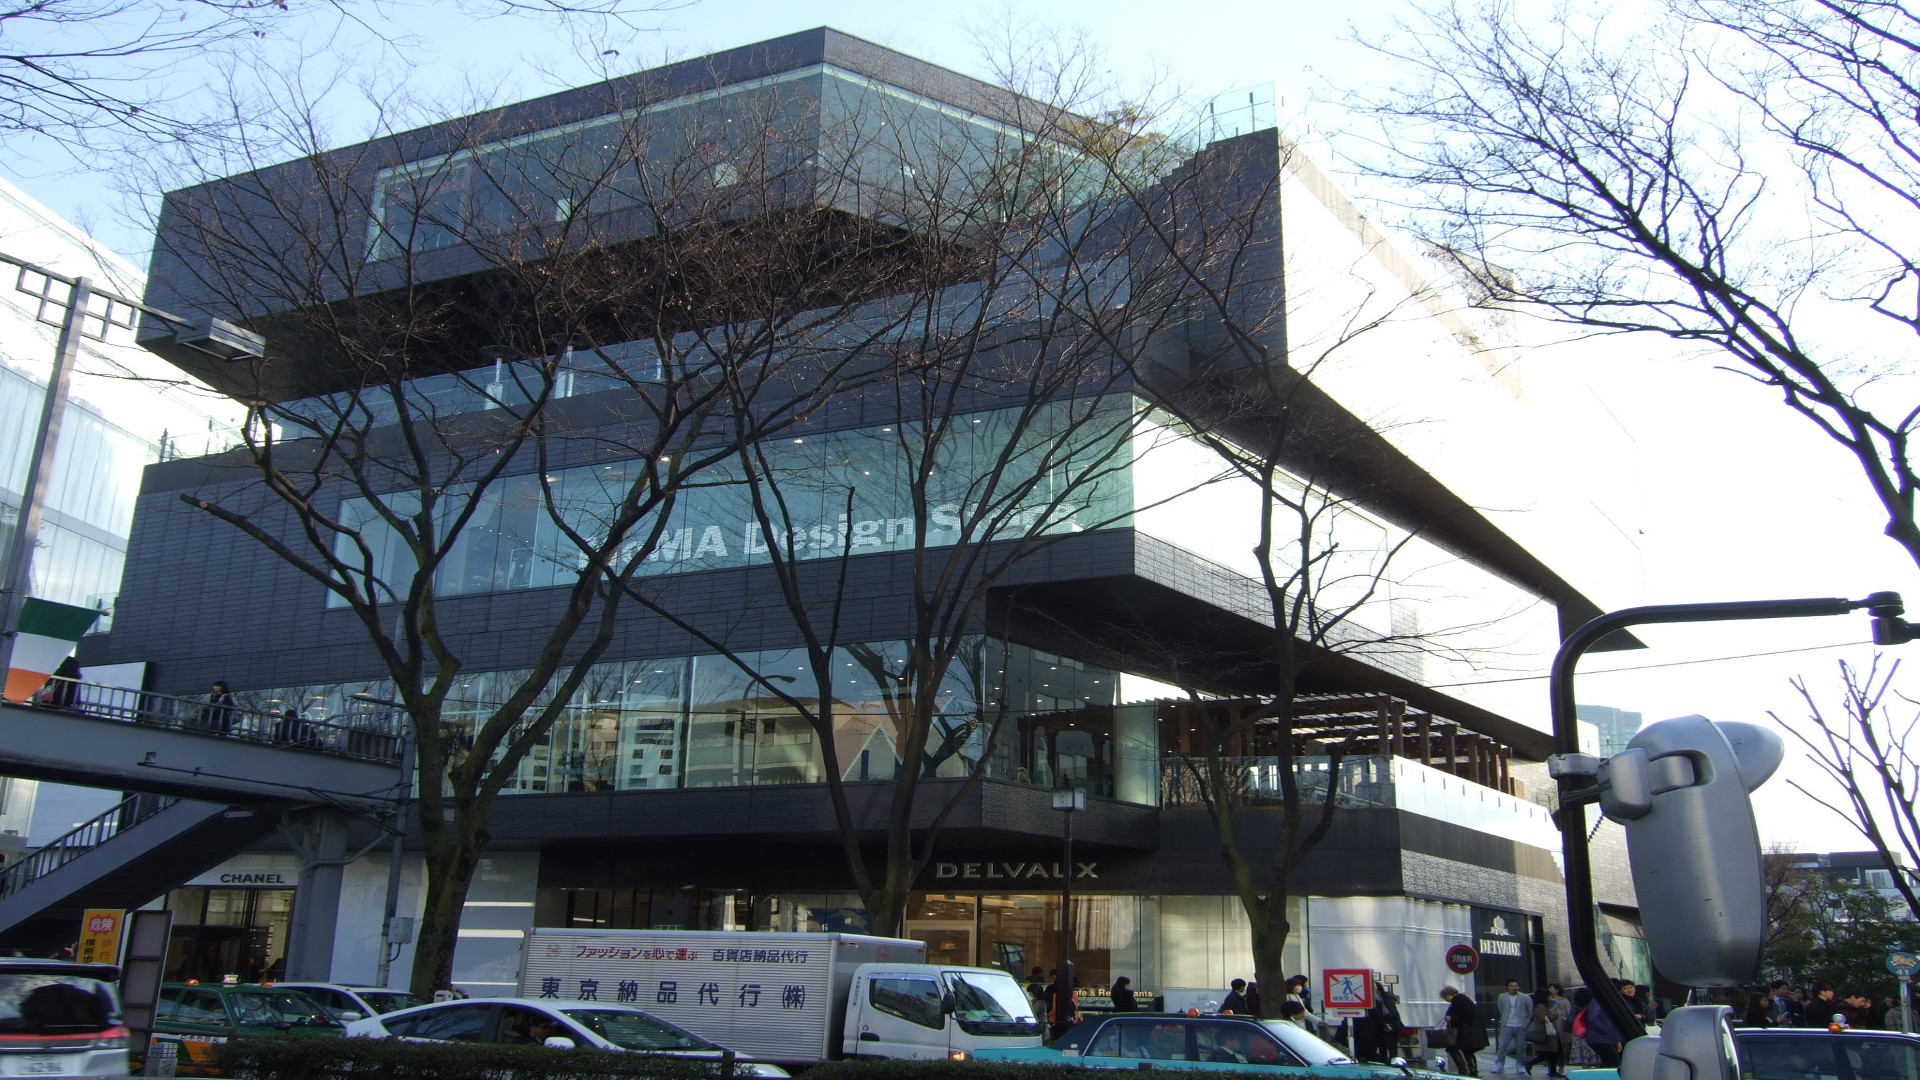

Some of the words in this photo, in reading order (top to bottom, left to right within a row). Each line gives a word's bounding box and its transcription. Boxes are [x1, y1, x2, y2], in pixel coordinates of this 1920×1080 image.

[744, 512, 914, 556] Design
[220, 873, 286, 884] CHANEL
[91, 918, 114, 931] 危険
[576, 945, 698, 961] ファッションを心で運ぶ
[712, 948, 809, 964] 百貨店納品代行
[1479, 939, 1522, 957] DELVAUX
